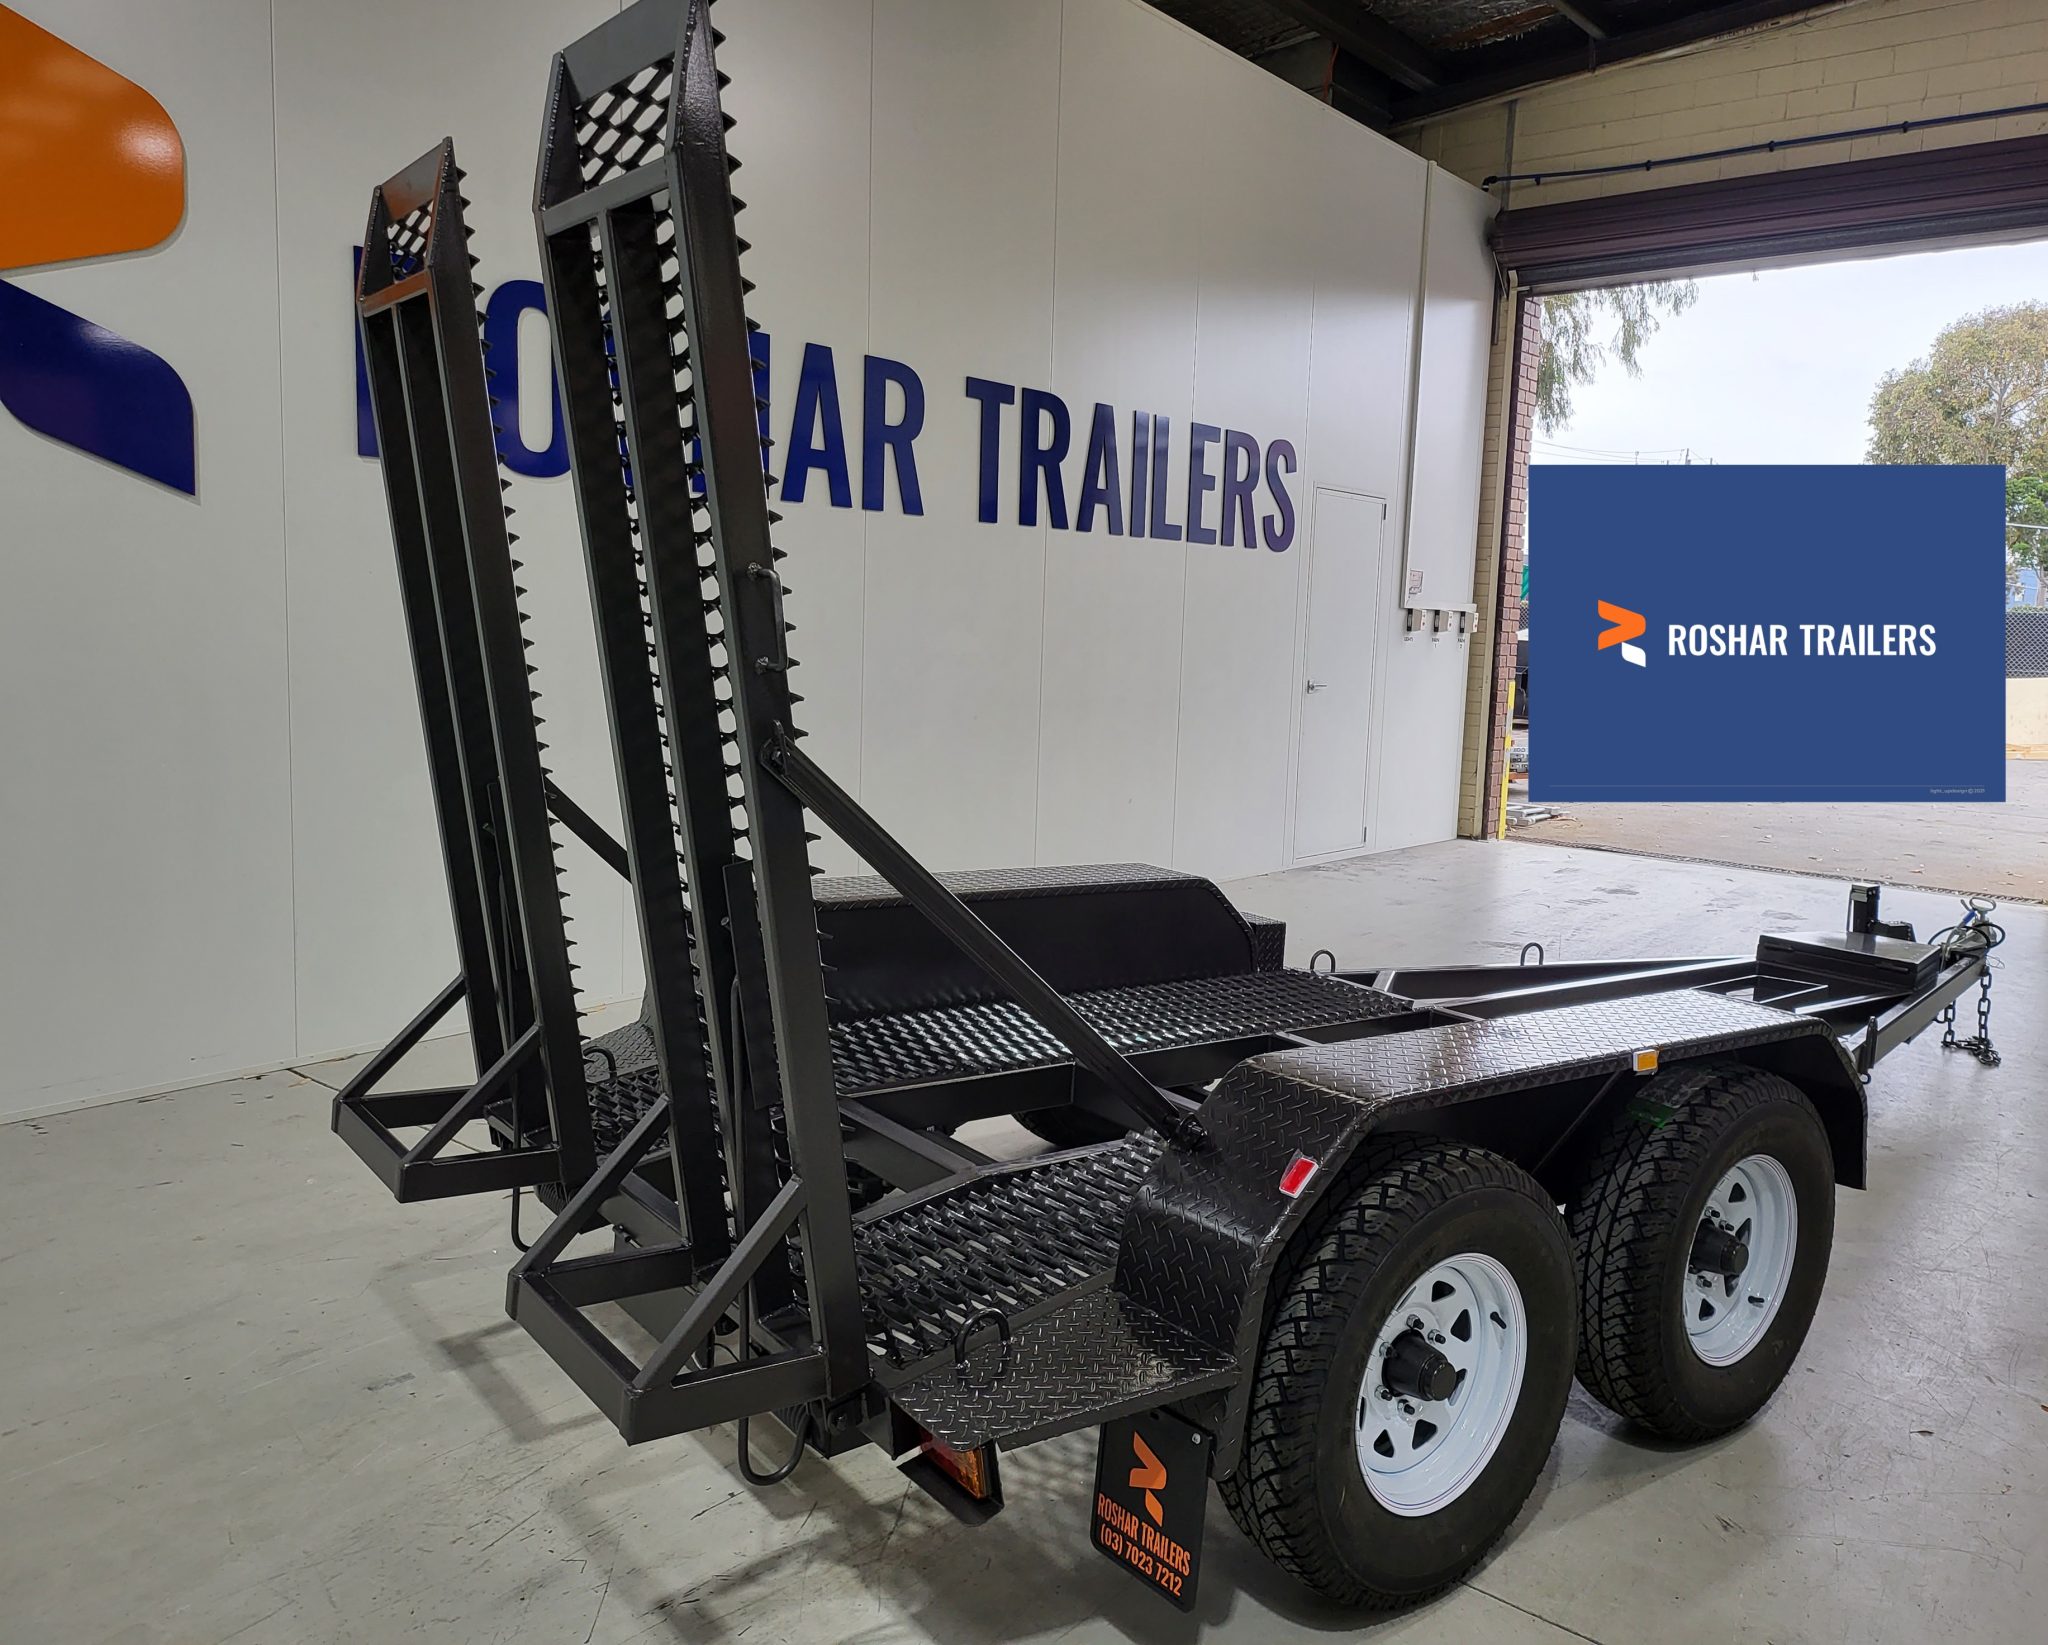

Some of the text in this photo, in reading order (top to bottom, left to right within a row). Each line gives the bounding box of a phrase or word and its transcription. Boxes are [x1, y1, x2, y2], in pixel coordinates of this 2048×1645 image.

[353, 245, 1298, 554] OAR TRAILERS
[1097, 1493, 1191, 1577] ROSHAR TRAILERS
[1100, 1523, 1183, 1597] (03) 7023 7212
